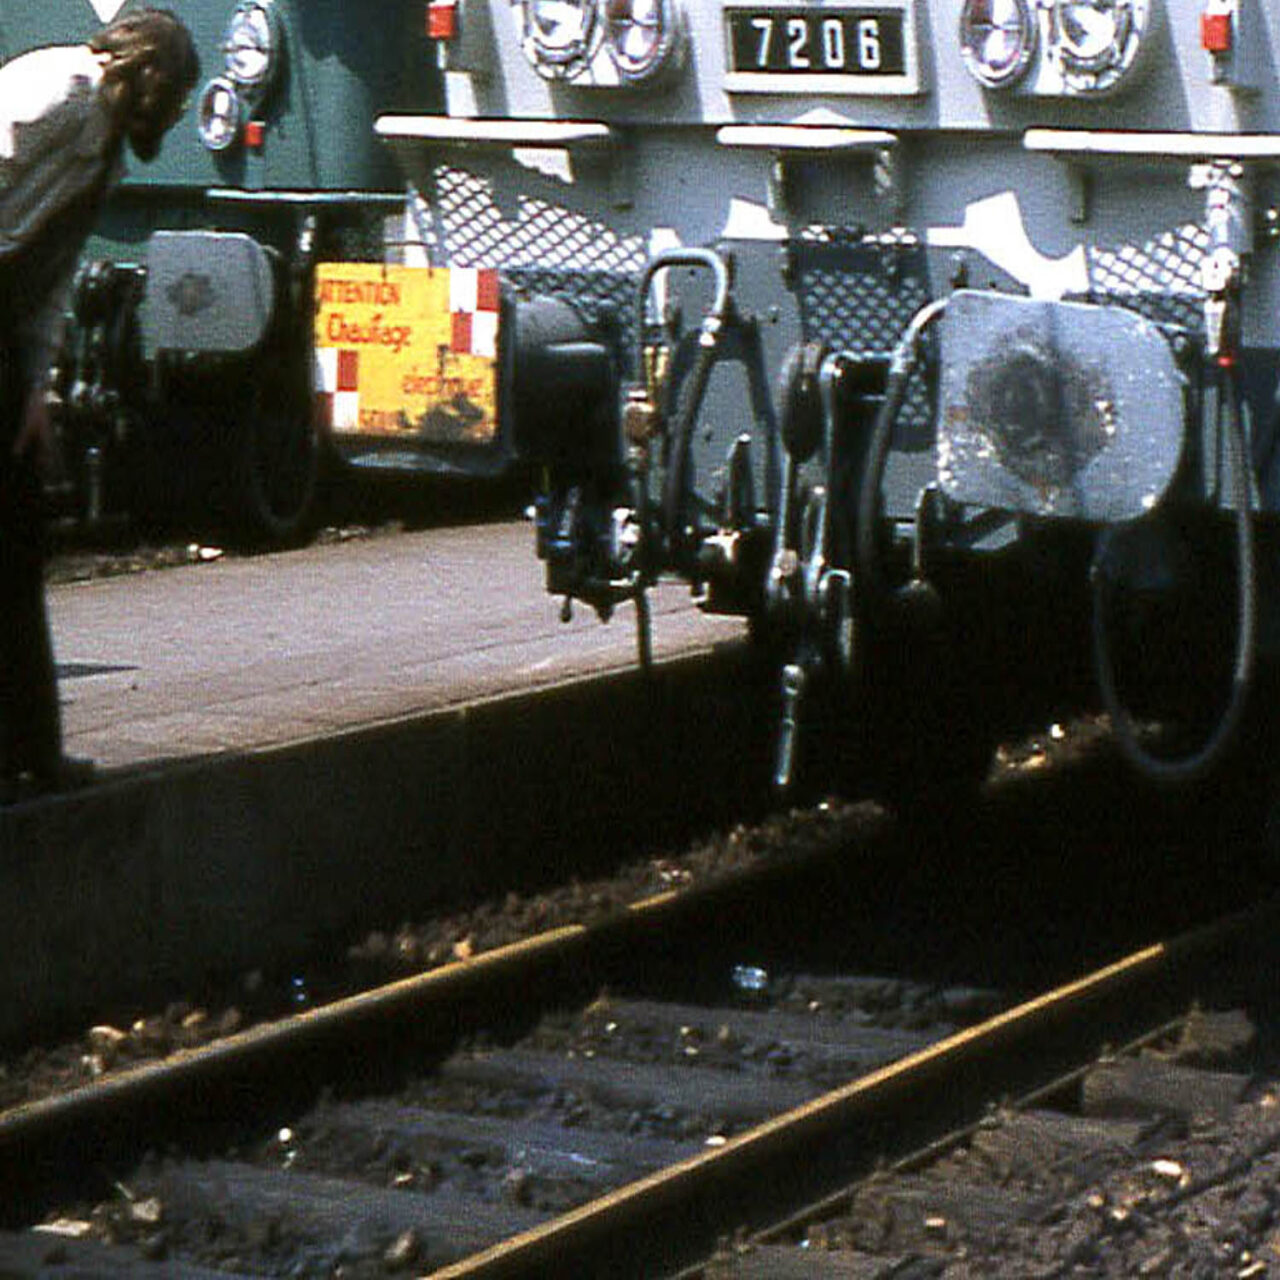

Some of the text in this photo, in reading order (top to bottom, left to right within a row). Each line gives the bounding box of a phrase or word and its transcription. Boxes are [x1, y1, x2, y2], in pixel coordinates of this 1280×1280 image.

[751, 18, 881, 68] 7206
[319, 280, 400, 304] ATTENTION
[327, 312, 411, 353] Chauffage
